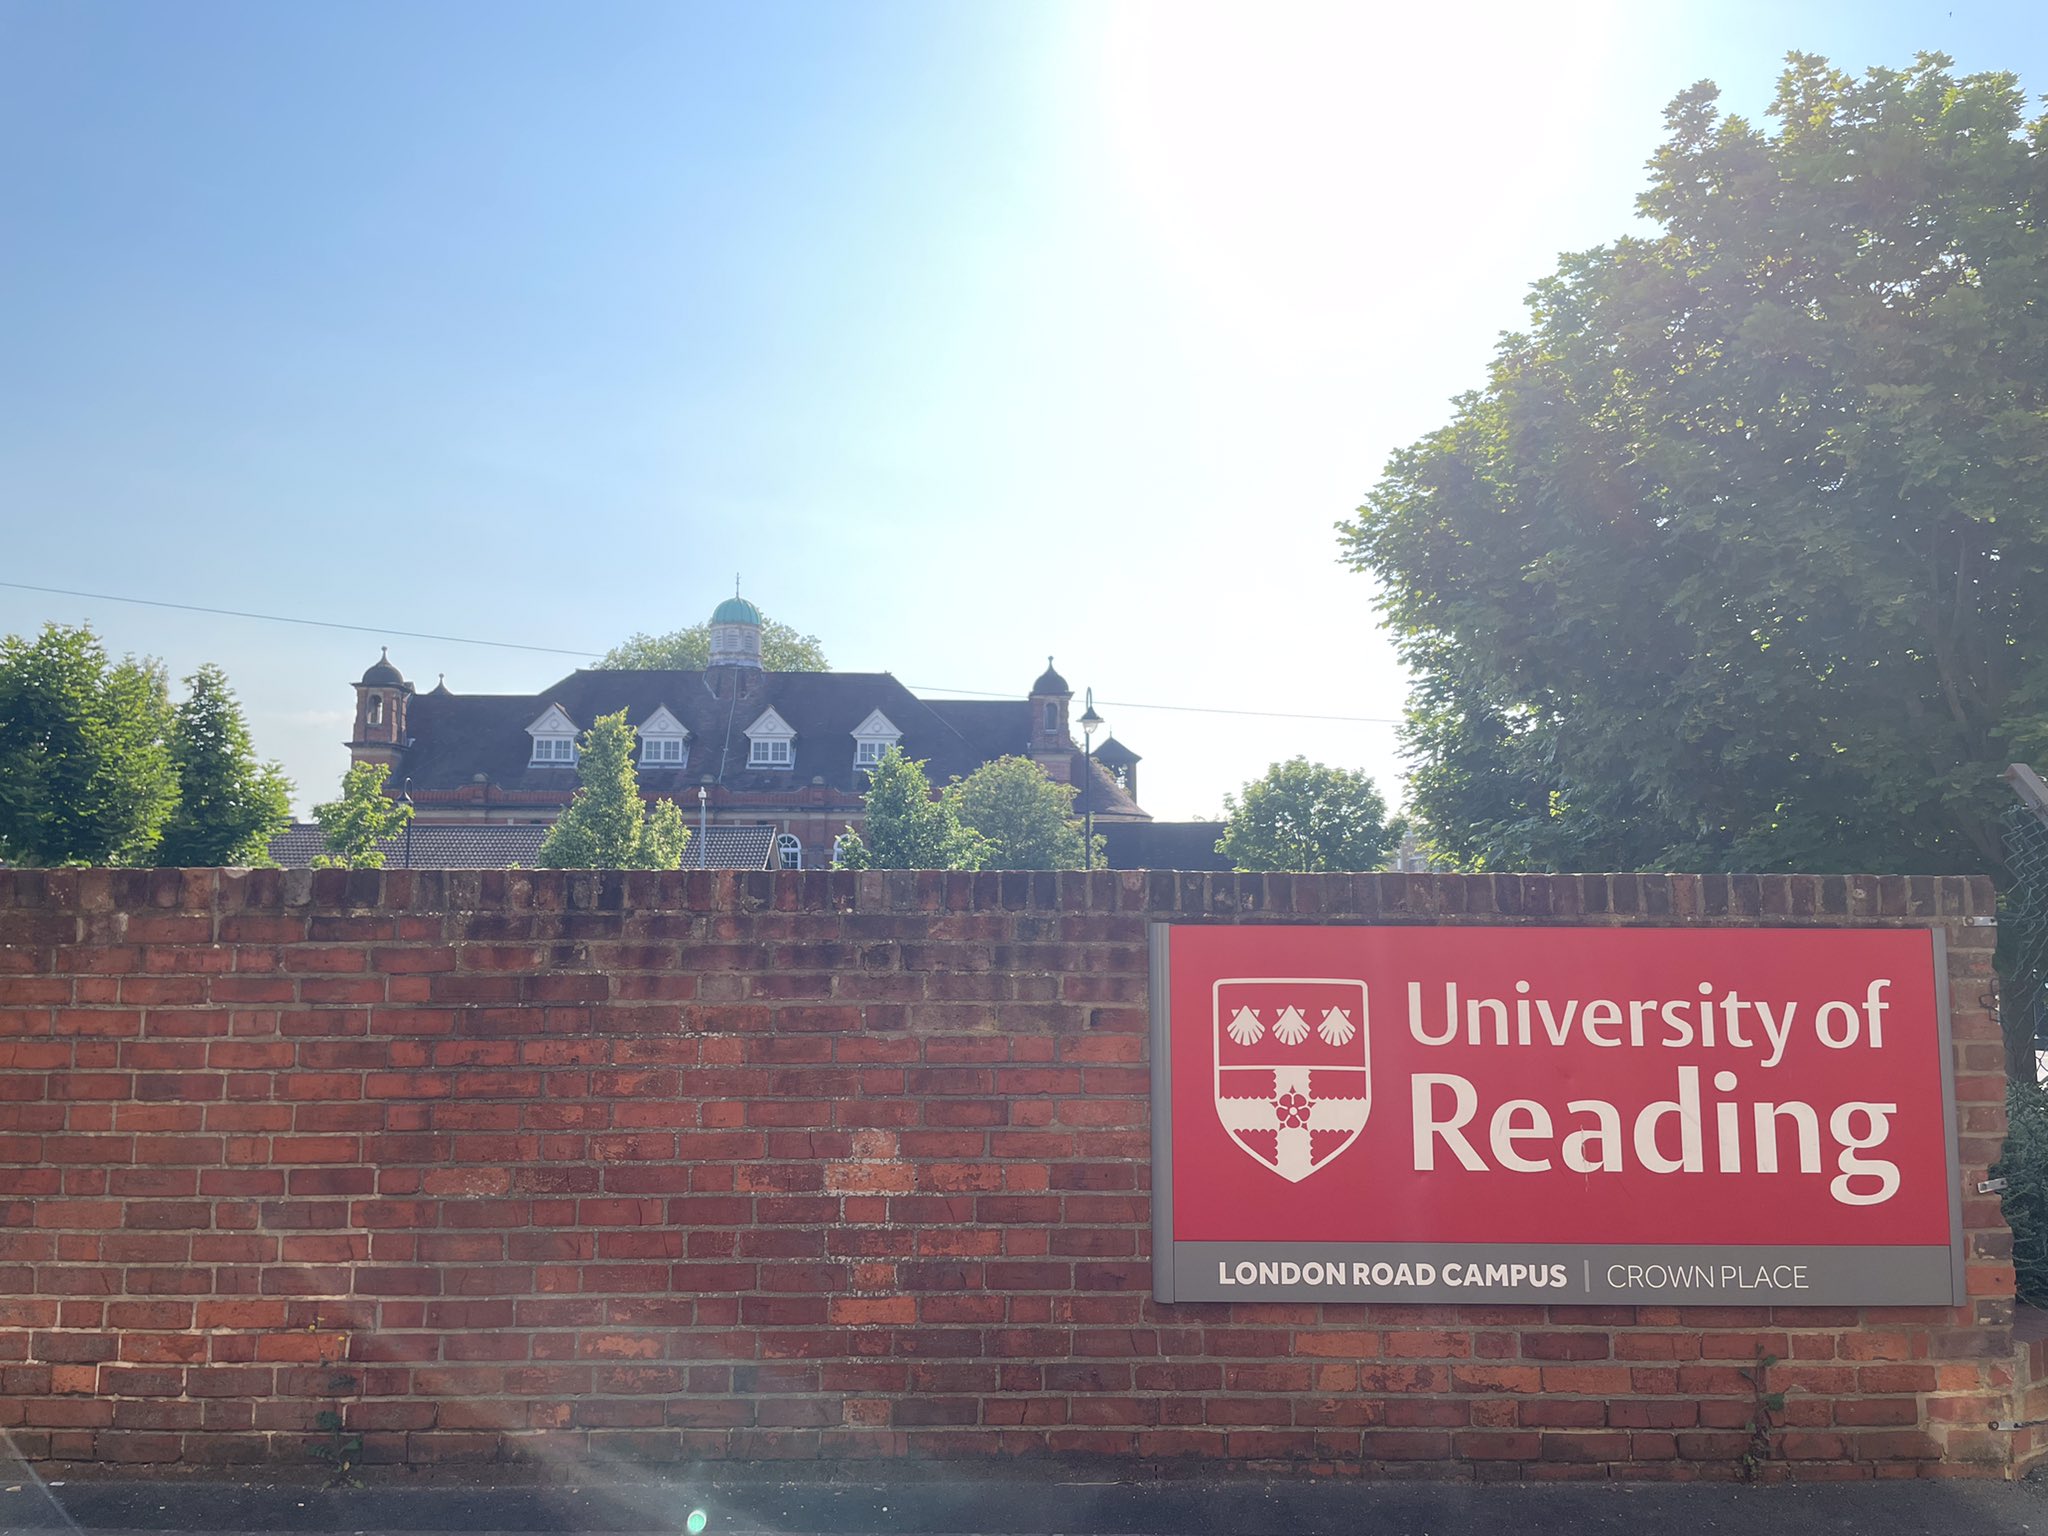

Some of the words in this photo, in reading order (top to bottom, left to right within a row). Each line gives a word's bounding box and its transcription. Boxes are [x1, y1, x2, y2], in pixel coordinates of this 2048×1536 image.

[1407, 980, 1798, 1069] University
[1815, 978, 1891, 1049] of
[1411, 1065, 1901, 1206] Reading
[1219, 1261, 1346, 1286] LONDON
[1352, 1262, 1436, 1286] ROAD
[1442, 1262, 1568, 1288] CAMPUS
[1607, 1264, 1714, 1289] CROWN
[1721, 1265, 1809, 1289] PLACE
